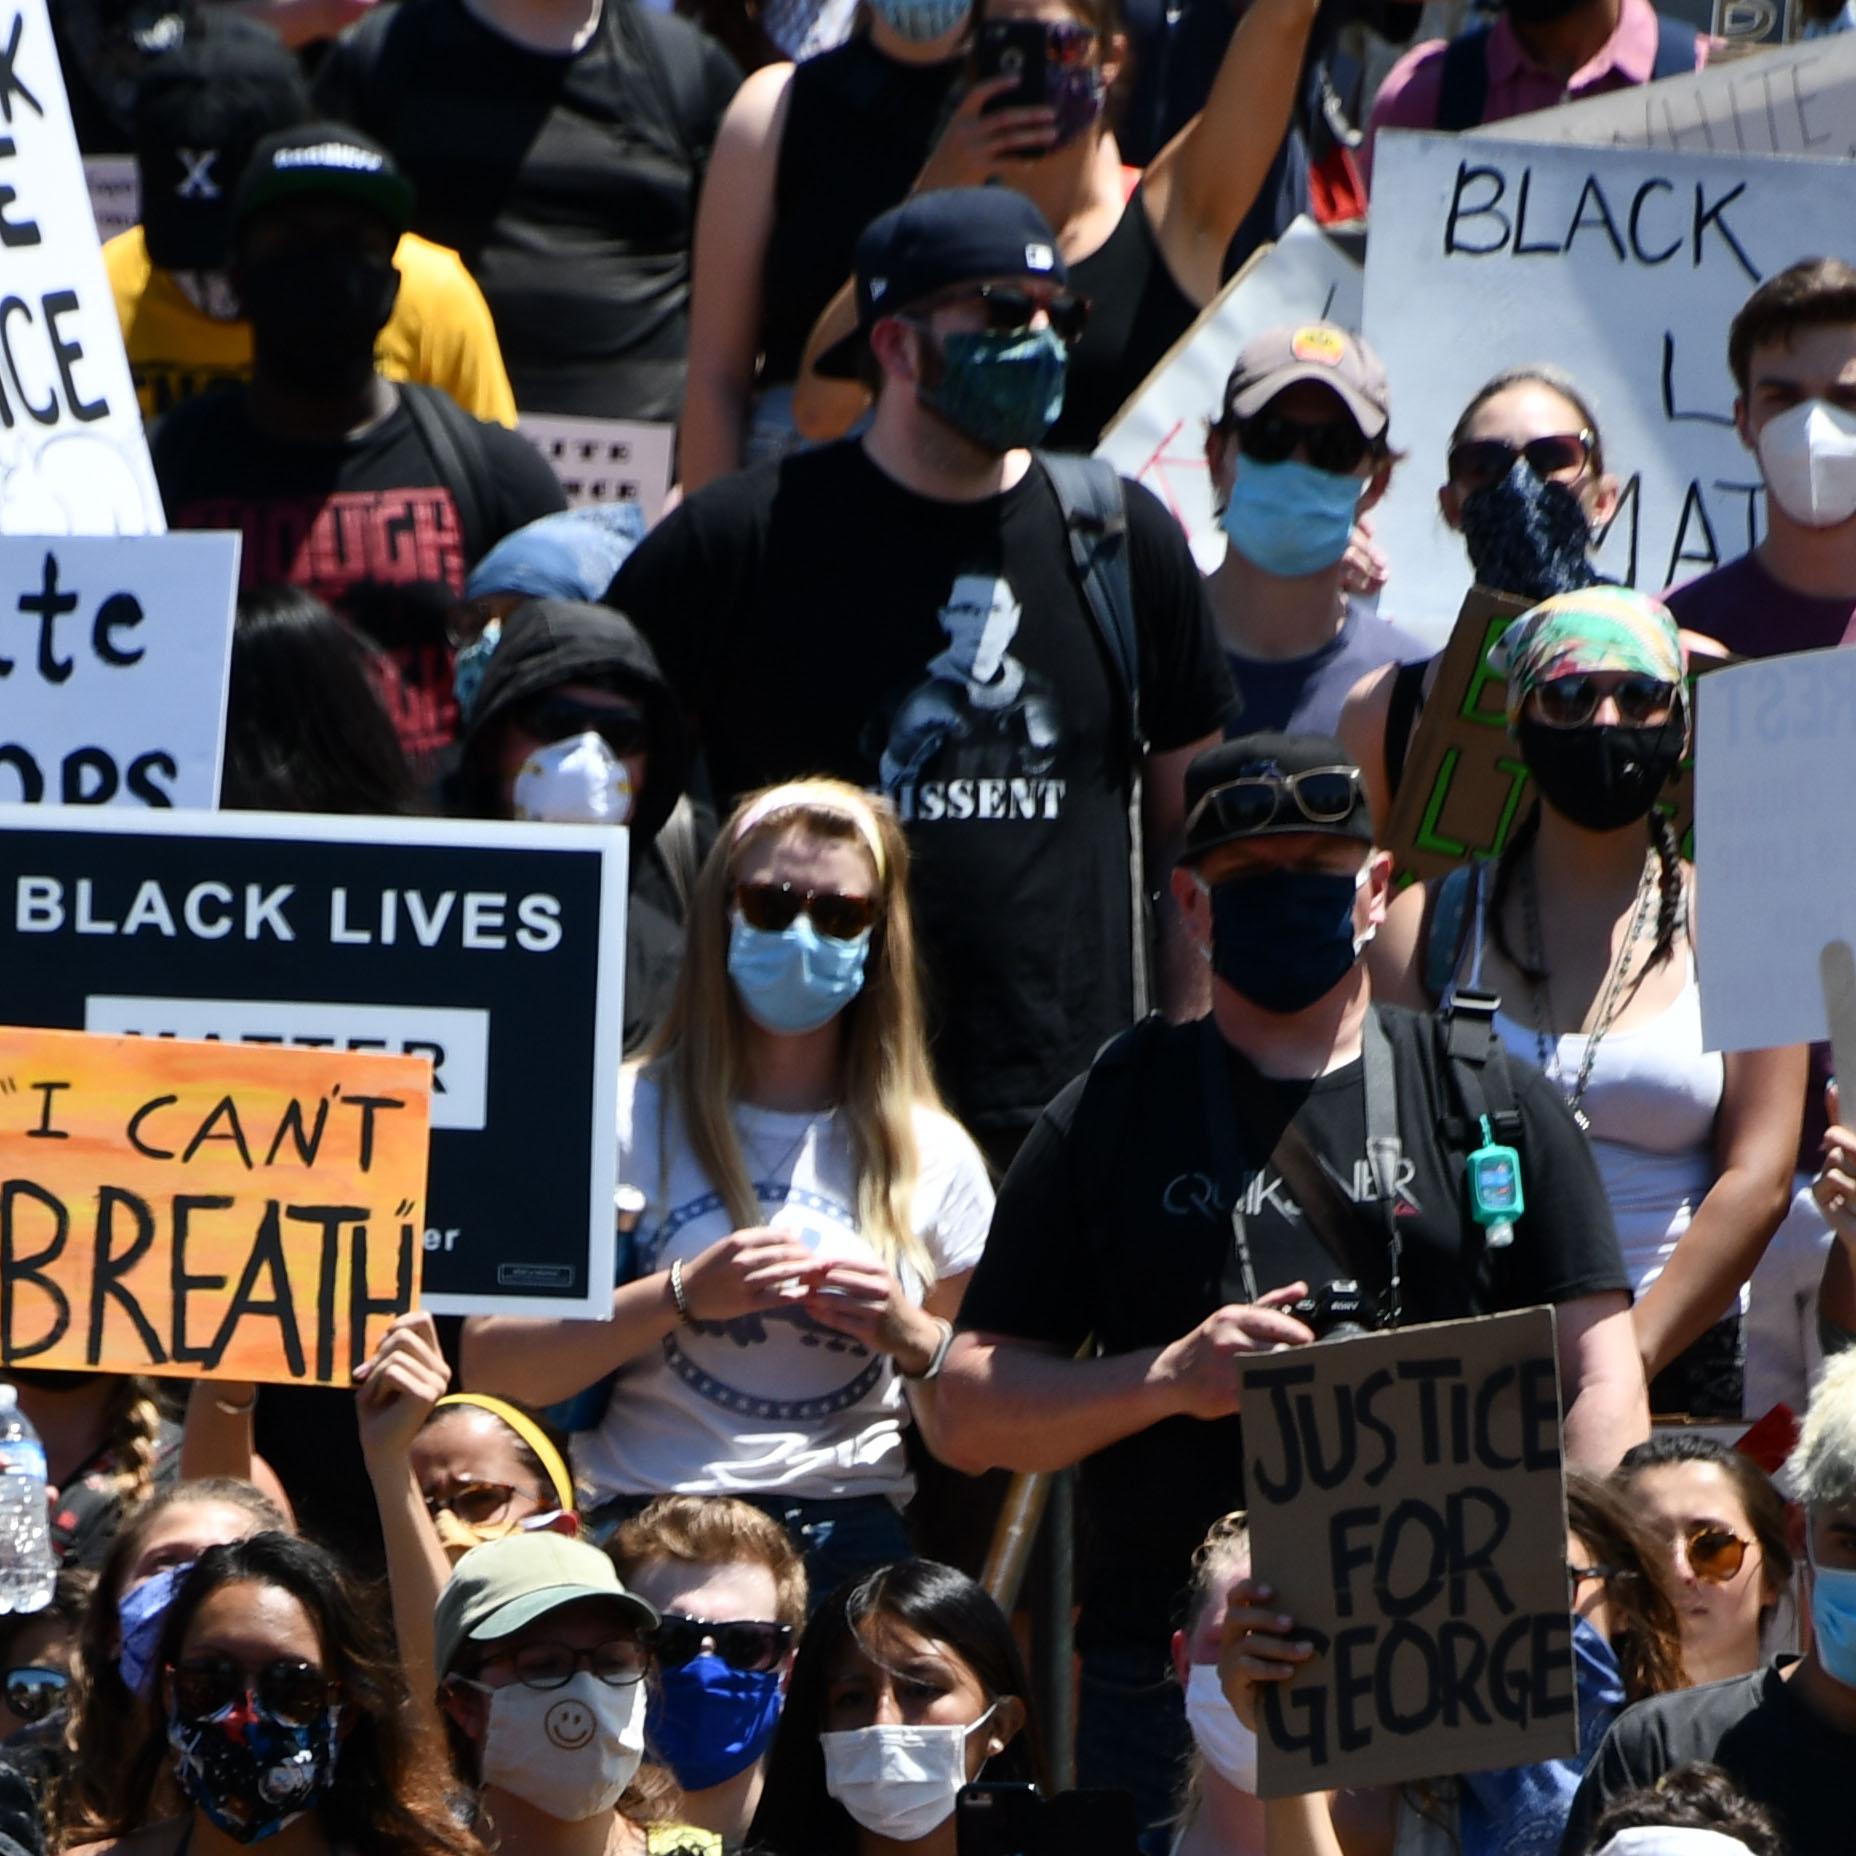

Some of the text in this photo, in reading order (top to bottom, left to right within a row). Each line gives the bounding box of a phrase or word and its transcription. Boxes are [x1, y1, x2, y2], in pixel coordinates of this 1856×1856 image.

[1444, 160, 1762, 283] BLACK
[898, 777, 1067, 822] ISSENT
[15, 875, 564, 953] BLACK LIVES
[125, 1083, 406, 1173] CAN'T
[1241, 1356, 1563, 1503] JUSTICE
[1328, 1486, 1517, 1618] FOR
[1261, 1612, 1573, 1767] GEORGE
